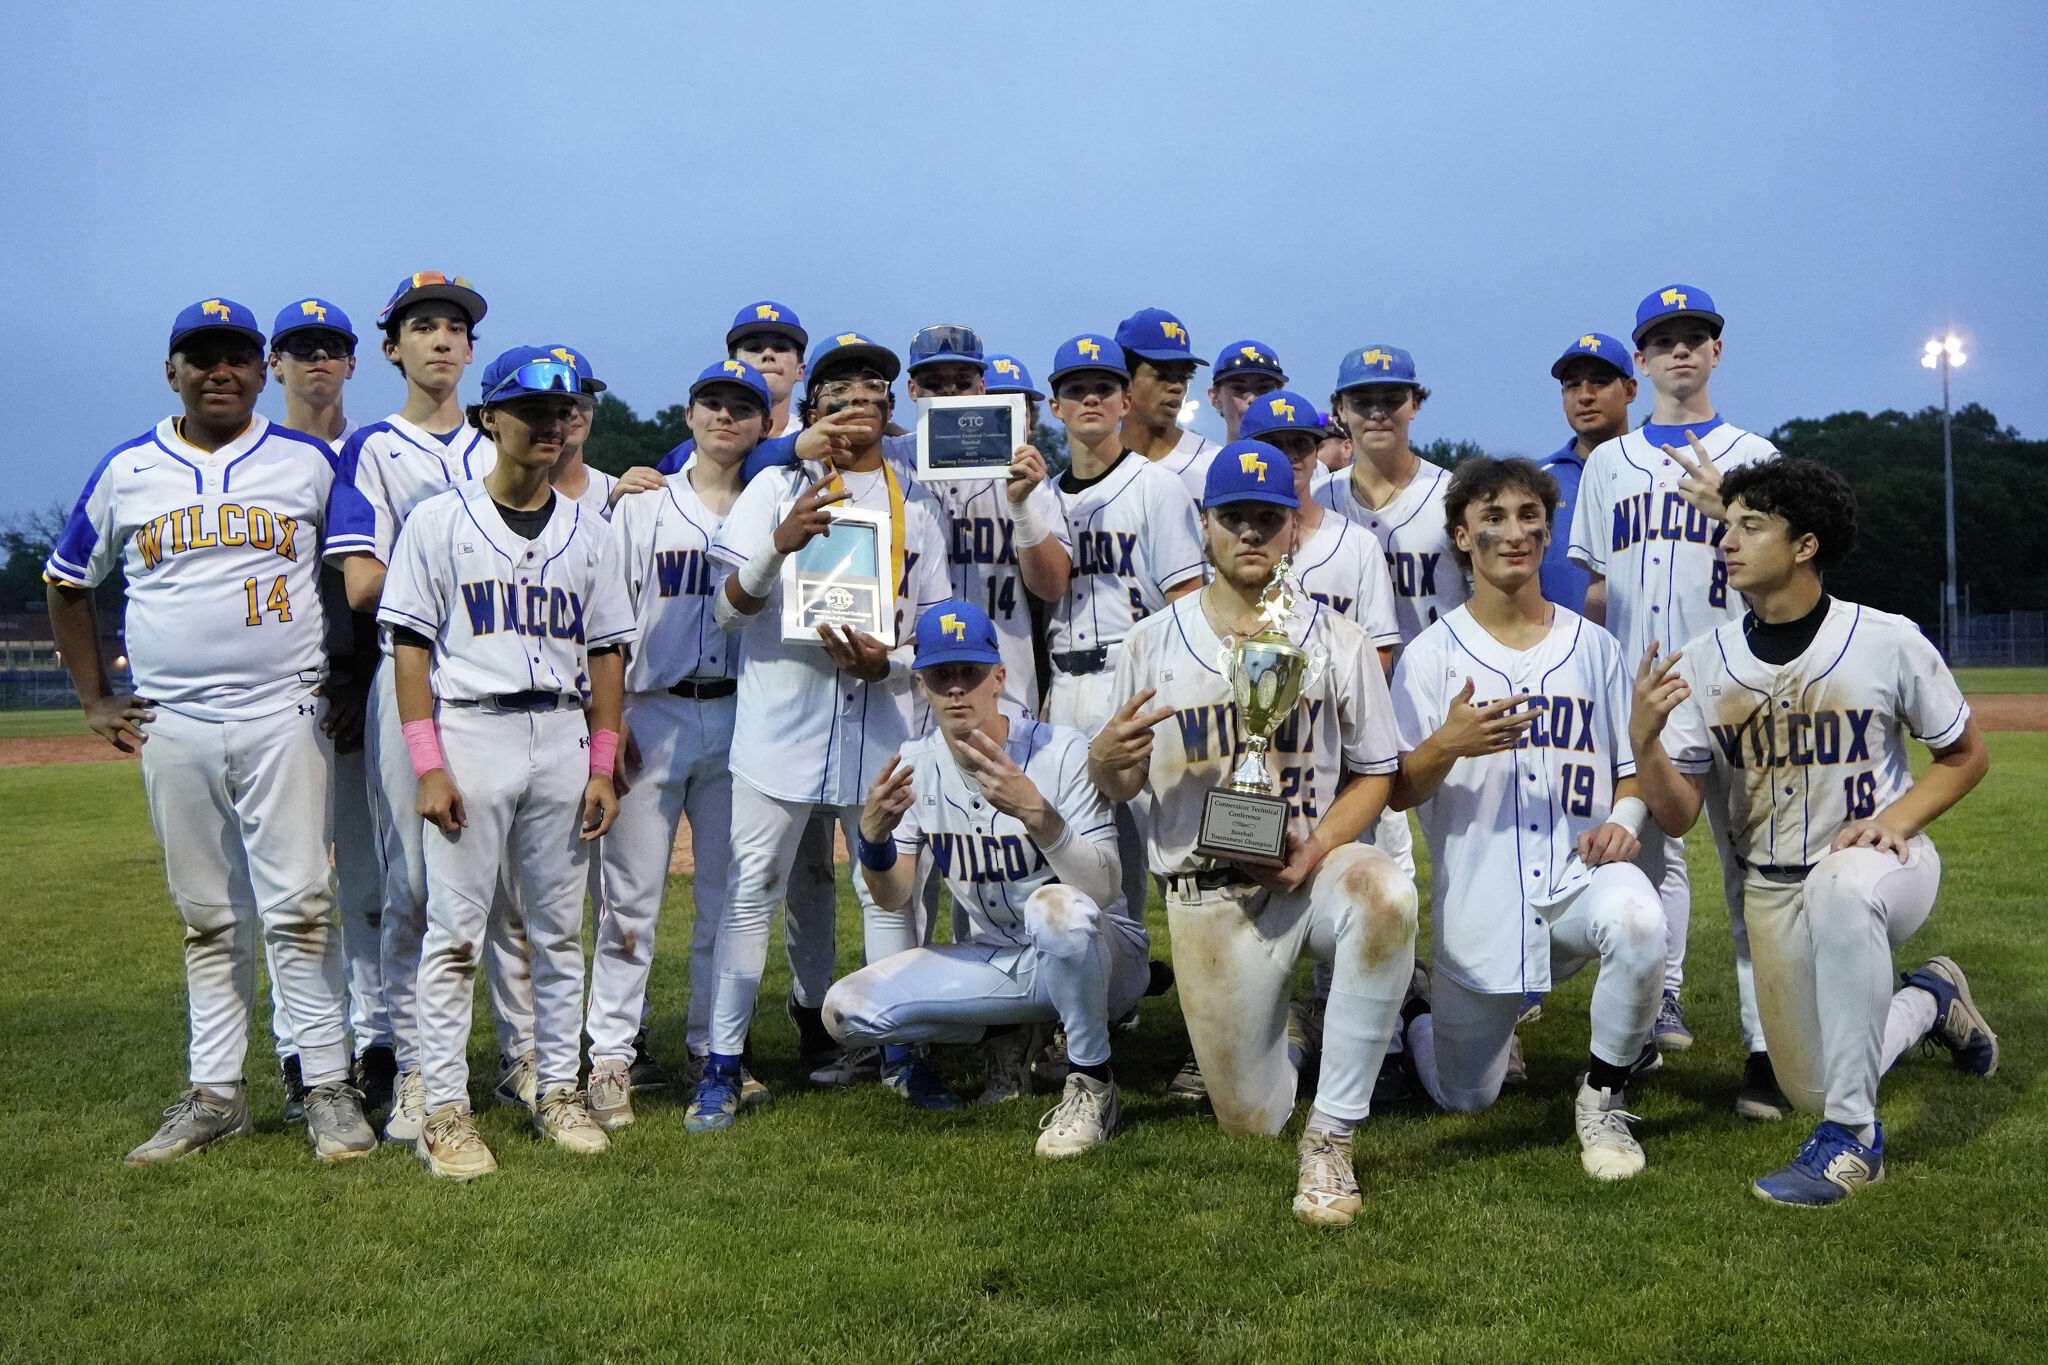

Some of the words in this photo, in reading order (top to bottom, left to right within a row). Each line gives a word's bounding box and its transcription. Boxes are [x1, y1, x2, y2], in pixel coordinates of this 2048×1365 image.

[1660, 288, 1687, 309] WT
[201, 300, 231, 322] WT
[301, 300, 327, 322] WT
[756, 304, 779, 321] WT
[836, 333, 868, 346] W
[1160, 321, 1186, 345] WT
[1580, 334, 1601, 352] WT
[1077, 338, 1100, 361] WT
[1363, 349, 1393, 370] WT
[723, 360, 746, 379] WT
[993, 359, 1020, 380] WT
[1269, 398, 1295, 422] WT
[957, 415, 984, 428] CTC
[1238, 452, 1267, 482] WT
[136, 503, 298, 570] WILCOX
[950, 517, 1018, 565] COX
[1708, 558, 1728, 610] 8
[244, 574, 293, 627] 14
[986, 575, 1016, 620] 14
[461, 578, 586, 646] WILCOX
[939, 613, 966, 641] WT
[1175, 697, 1323, 763] WILOX
[1708, 708, 1874, 769] WILCOX
[1561, 763, 1595, 818] 19
[1214, 800, 1250, 812] Connecticut
[1251, 805, 1279, 816] Technical
[1228, 811, 1262, 821] Conference
[1210, 833, 1244, 843] Tournament
[1244, 838, 1273, 849] Champion
[1231, 829, 1254, 838] Baseball
